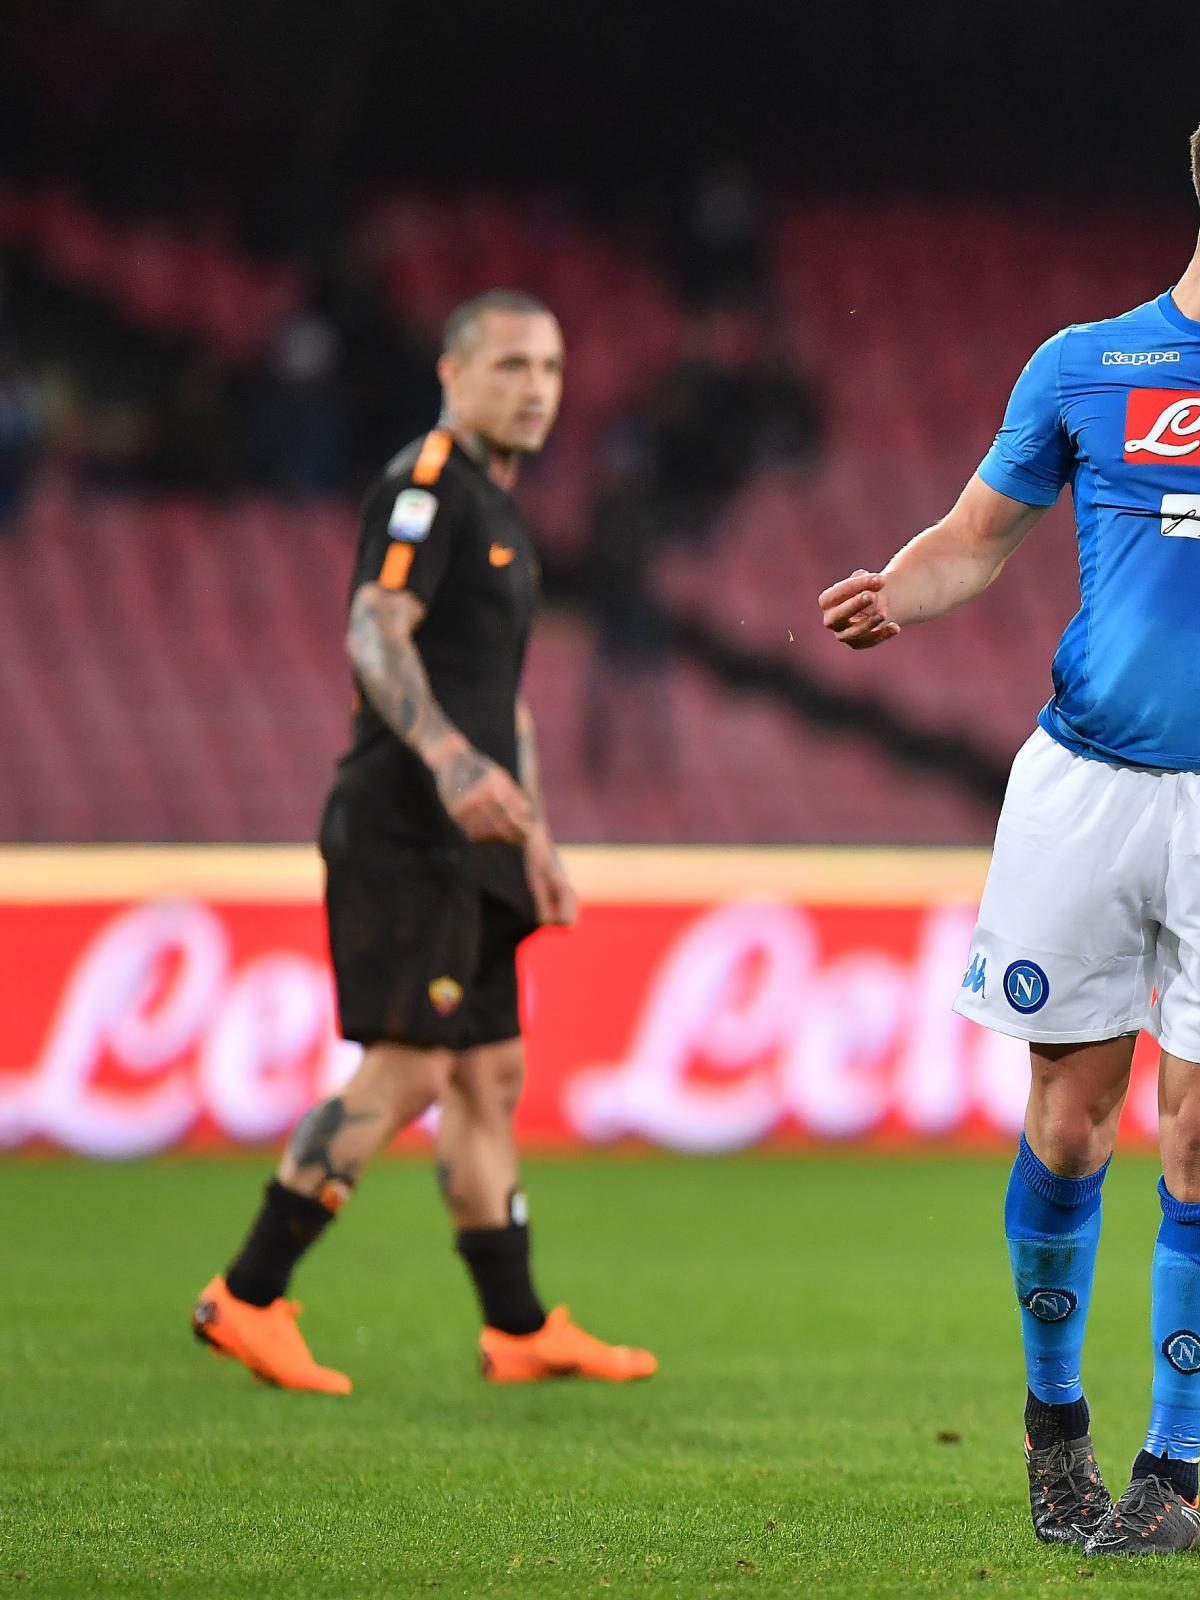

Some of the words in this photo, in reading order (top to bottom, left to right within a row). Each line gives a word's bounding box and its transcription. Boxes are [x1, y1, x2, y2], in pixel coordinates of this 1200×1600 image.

[1102, 352, 1180, 366] Kappa
[1013, 974, 1038, 1002] N
[1040, 1297, 1059, 1315] N
[1177, 1341, 1197, 1364] N
